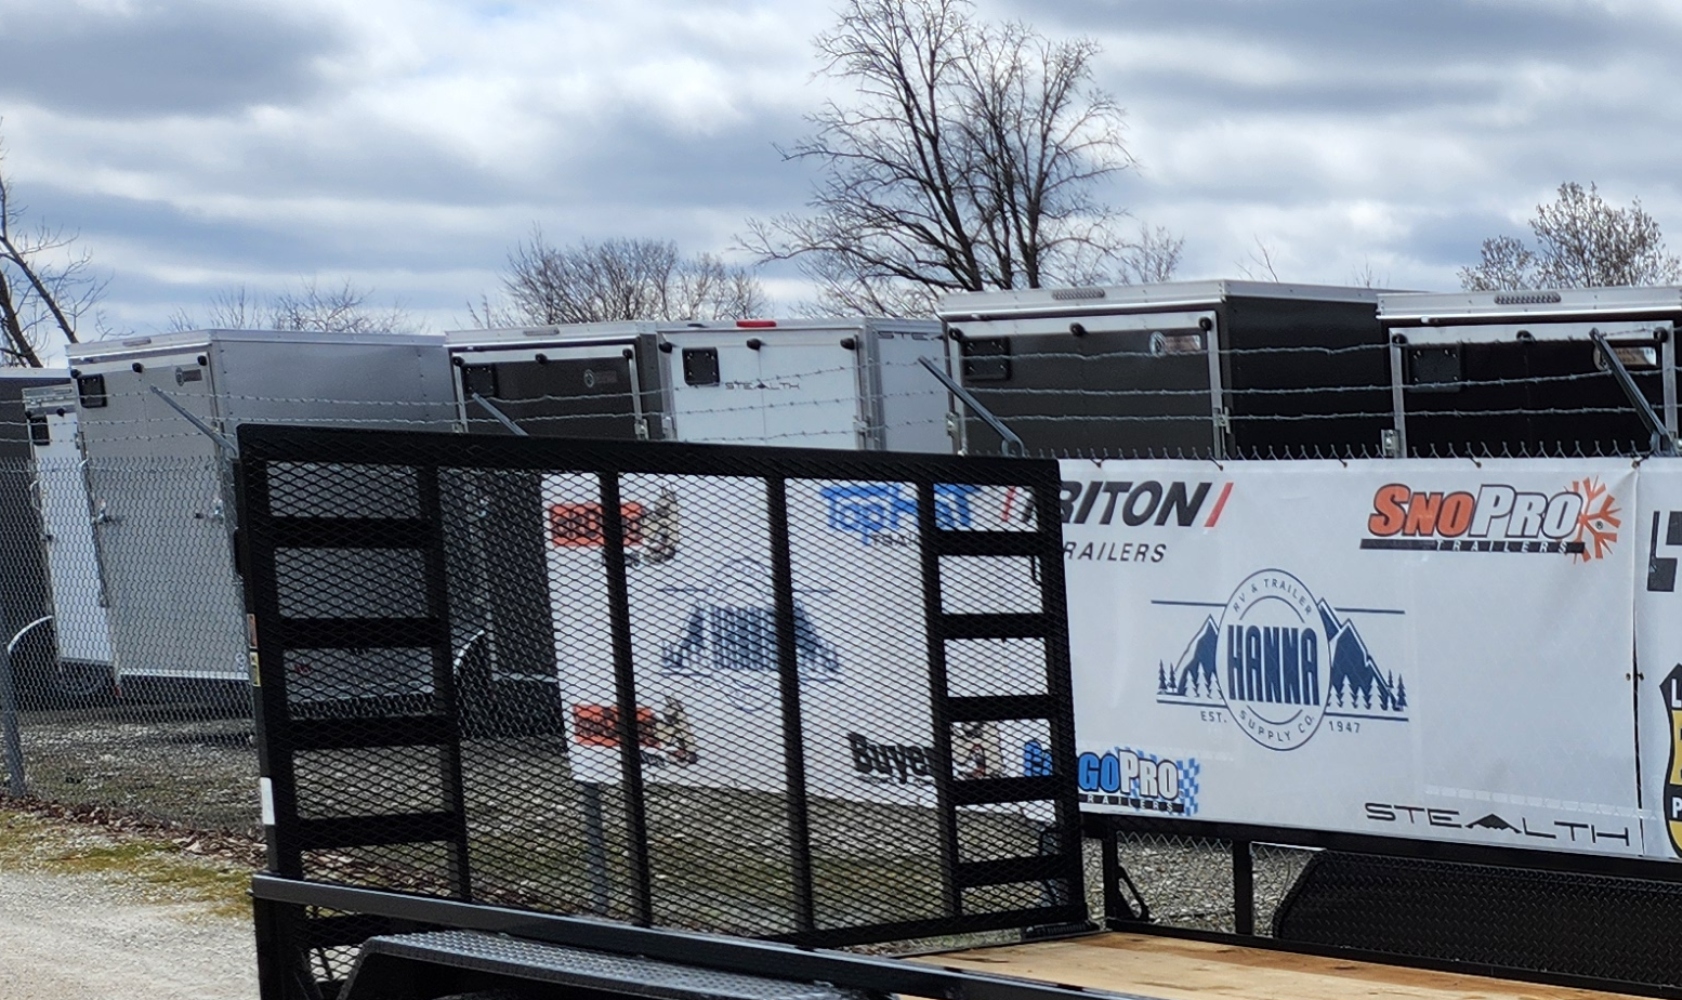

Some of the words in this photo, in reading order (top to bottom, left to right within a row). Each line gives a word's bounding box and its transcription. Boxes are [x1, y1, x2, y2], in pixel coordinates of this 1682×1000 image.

[1058, 480, 1213, 527] RITON
[1062, 541, 1167, 563] RAILERS
[1436, 540, 1568, 554] TRAILERS
[1233, 593, 1246, 613] RV
[1263, 578, 1313, 615] TRAILER
[1227, 624, 1321, 707] HANNA
[1200, 710, 1228, 724] EST.
[1239, 710, 1291, 742] SUPPLY
[1328, 720, 1361, 734] 1947
[1086, 793, 1174, 813] RAILERS
[1364, 802, 1630, 847] STEALTH
